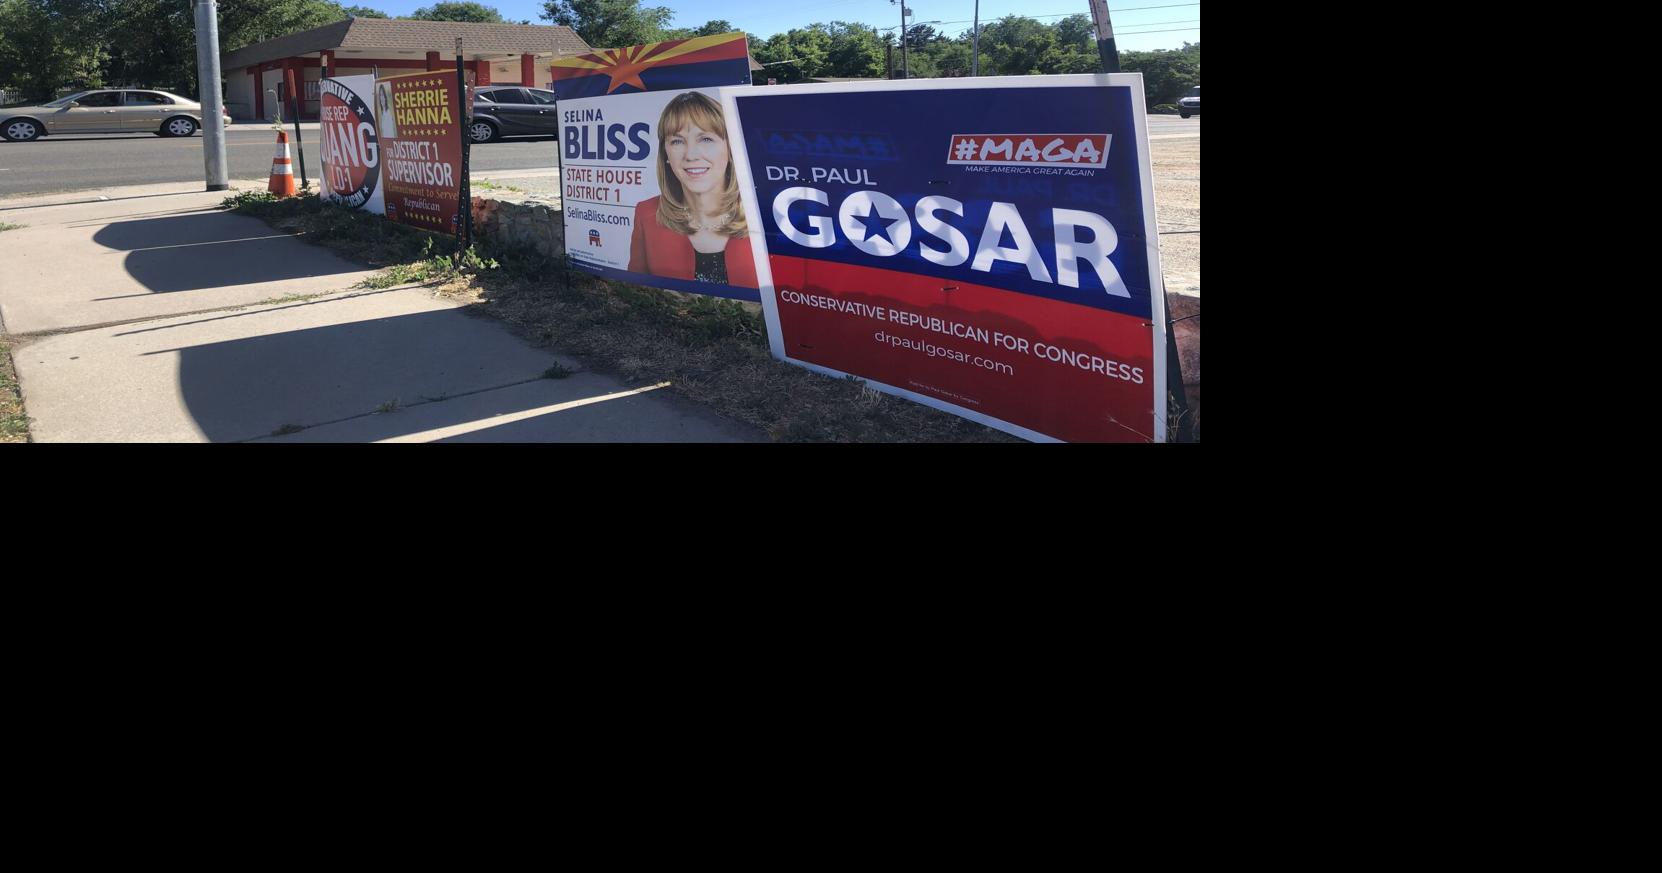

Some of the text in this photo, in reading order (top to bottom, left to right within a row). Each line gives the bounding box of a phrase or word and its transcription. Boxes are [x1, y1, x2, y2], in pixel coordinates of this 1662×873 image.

[394, 88, 448, 108] SHERRIE
[333, 106, 348, 120] REP
[396, 106, 452, 126] HANNA
[564, 108, 603, 122] SELINA
[393, 141, 430, 160] DISTRICT
[432, 142, 438, 160] 1
[564, 122, 650, 161] BLISS
[955, 138, 1101, 163] #MAGA
[387, 159, 454, 187] SUPERVISOR
[566, 168, 642, 185] STATE HOUSE
[811, 167, 878, 186] PAUL
[965, 165, 1095, 177] MAKE AMERICA GREAT AGAIN
[566, 185, 620, 202] DISTRICT 1
[567, 206, 630, 226] SelinaBliss.com
[772, 186, 1132, 298] GOSAR
[780, 290, 1144, 384] CONSERVATIVE REPUBLICAN FOR CONGRESS
[874, 331, 1014, 376] drpaulgosar.com
